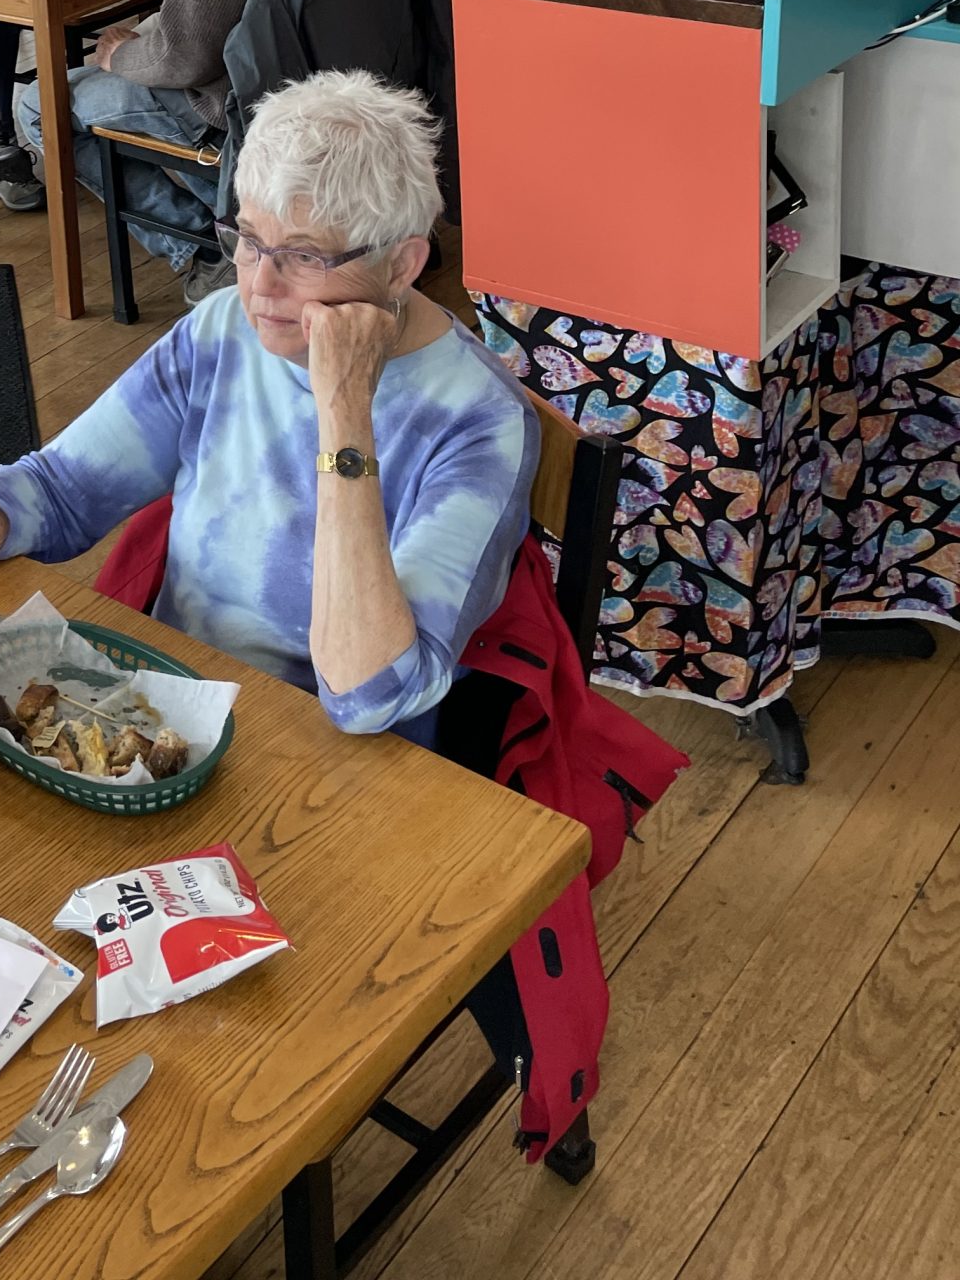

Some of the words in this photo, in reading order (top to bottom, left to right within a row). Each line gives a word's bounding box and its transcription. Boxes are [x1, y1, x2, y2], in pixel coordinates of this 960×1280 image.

[177, 864, 198, 893] CHIPS
[141, 869, 189, 917] Original
[189, 889, 213, 913] POTATO
[103, 945, 119, 970] GLUTEN
[112, 939, 131, 966] FREE
